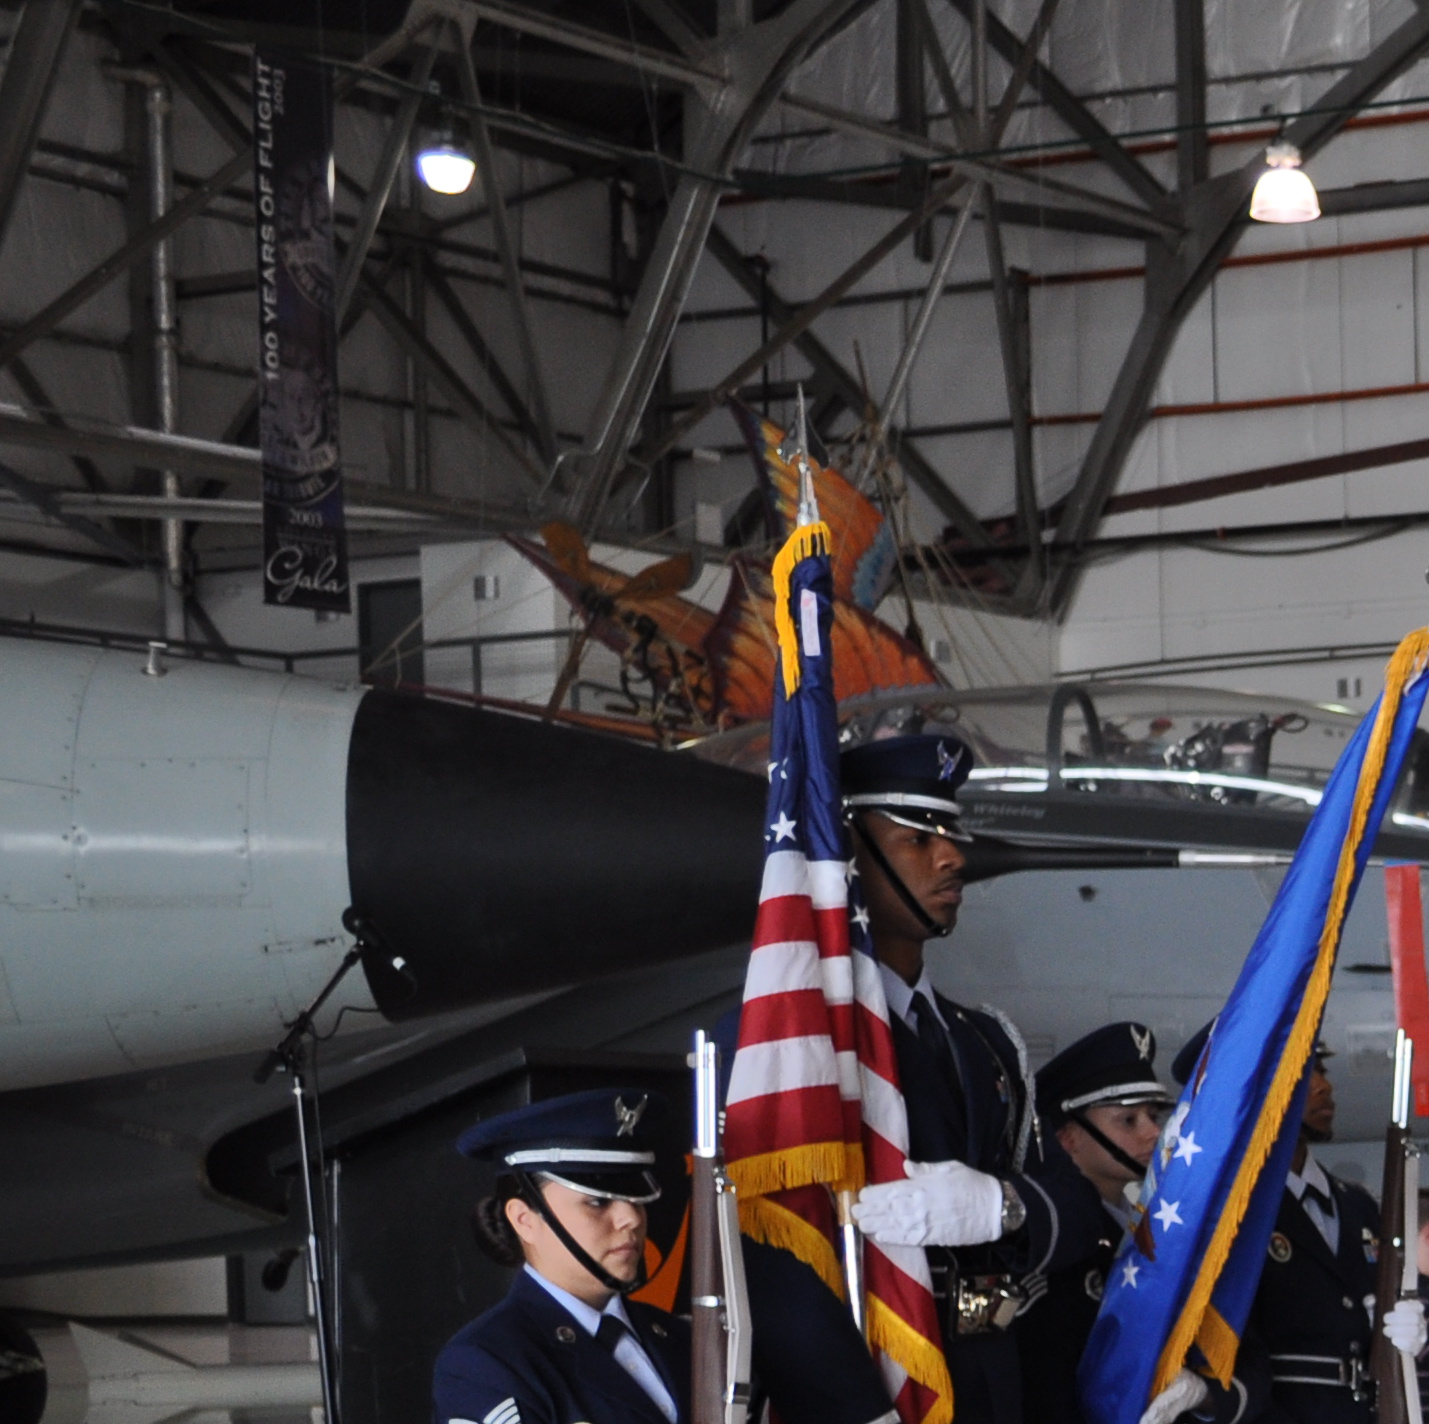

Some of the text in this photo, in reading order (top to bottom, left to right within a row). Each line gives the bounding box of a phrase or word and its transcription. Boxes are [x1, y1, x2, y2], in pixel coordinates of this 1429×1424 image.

[256, 57, 280, 382] 100 YEARS OF FLIGHT
[266, 546, 349, 603] Gala
